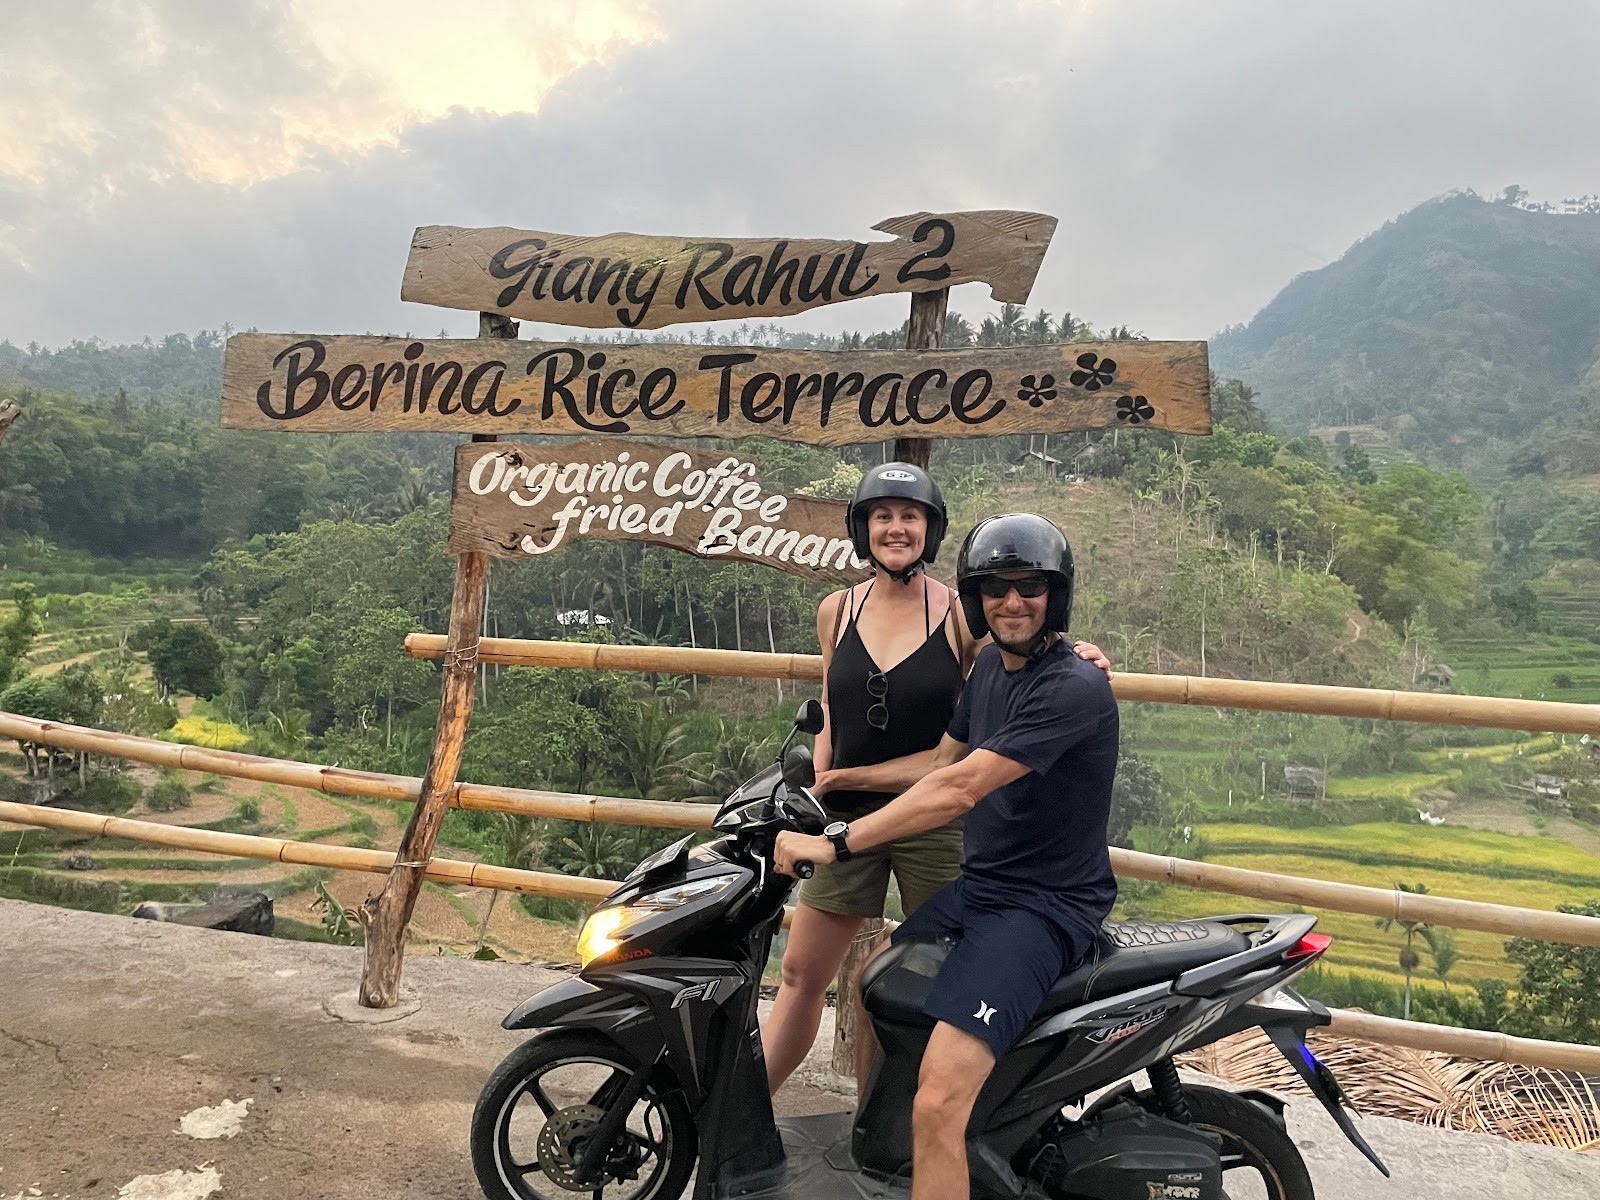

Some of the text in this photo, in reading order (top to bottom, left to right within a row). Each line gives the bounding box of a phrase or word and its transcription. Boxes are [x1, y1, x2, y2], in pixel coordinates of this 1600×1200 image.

[489, 218, 956, 328] Giang Rahul 2
[257, 339, 1007, 433] Berina Rice Terrace
[469, 451, 788, 523] Organic Coffee
[520, 495, 685, 555] fried
